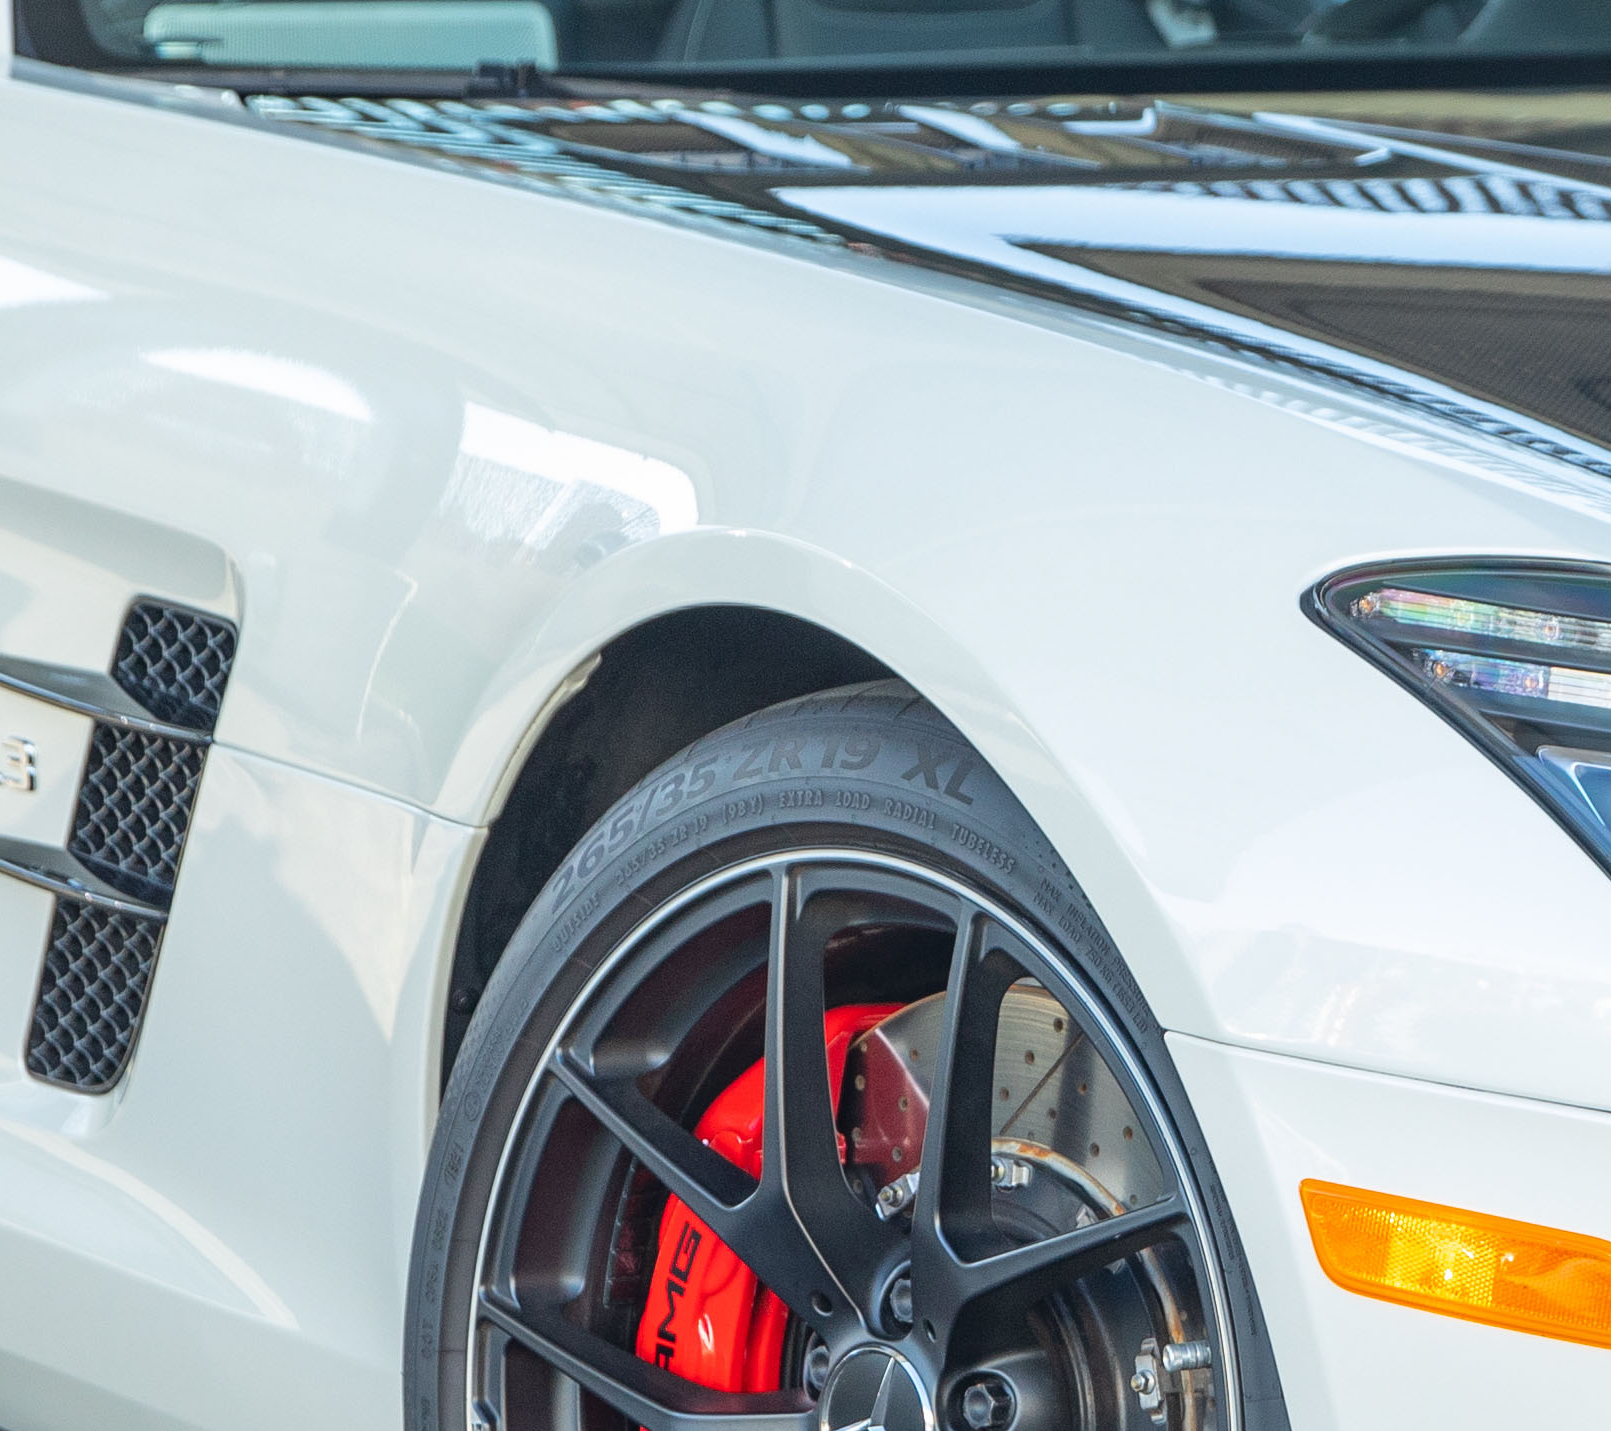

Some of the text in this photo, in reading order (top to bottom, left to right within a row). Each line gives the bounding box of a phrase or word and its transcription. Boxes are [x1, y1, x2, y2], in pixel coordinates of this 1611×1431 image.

[550, 734, 975, 915] 265/35 ZR 19 XL
[551, 894, 600, 953] OUTSIDE
[778, 789, 825, 808] EXTRA
[835, 790, 872, 810] LOAD
[884, 799, 936, 831] RADIAL
[951, 822, 1016, 875] TUBELESS
